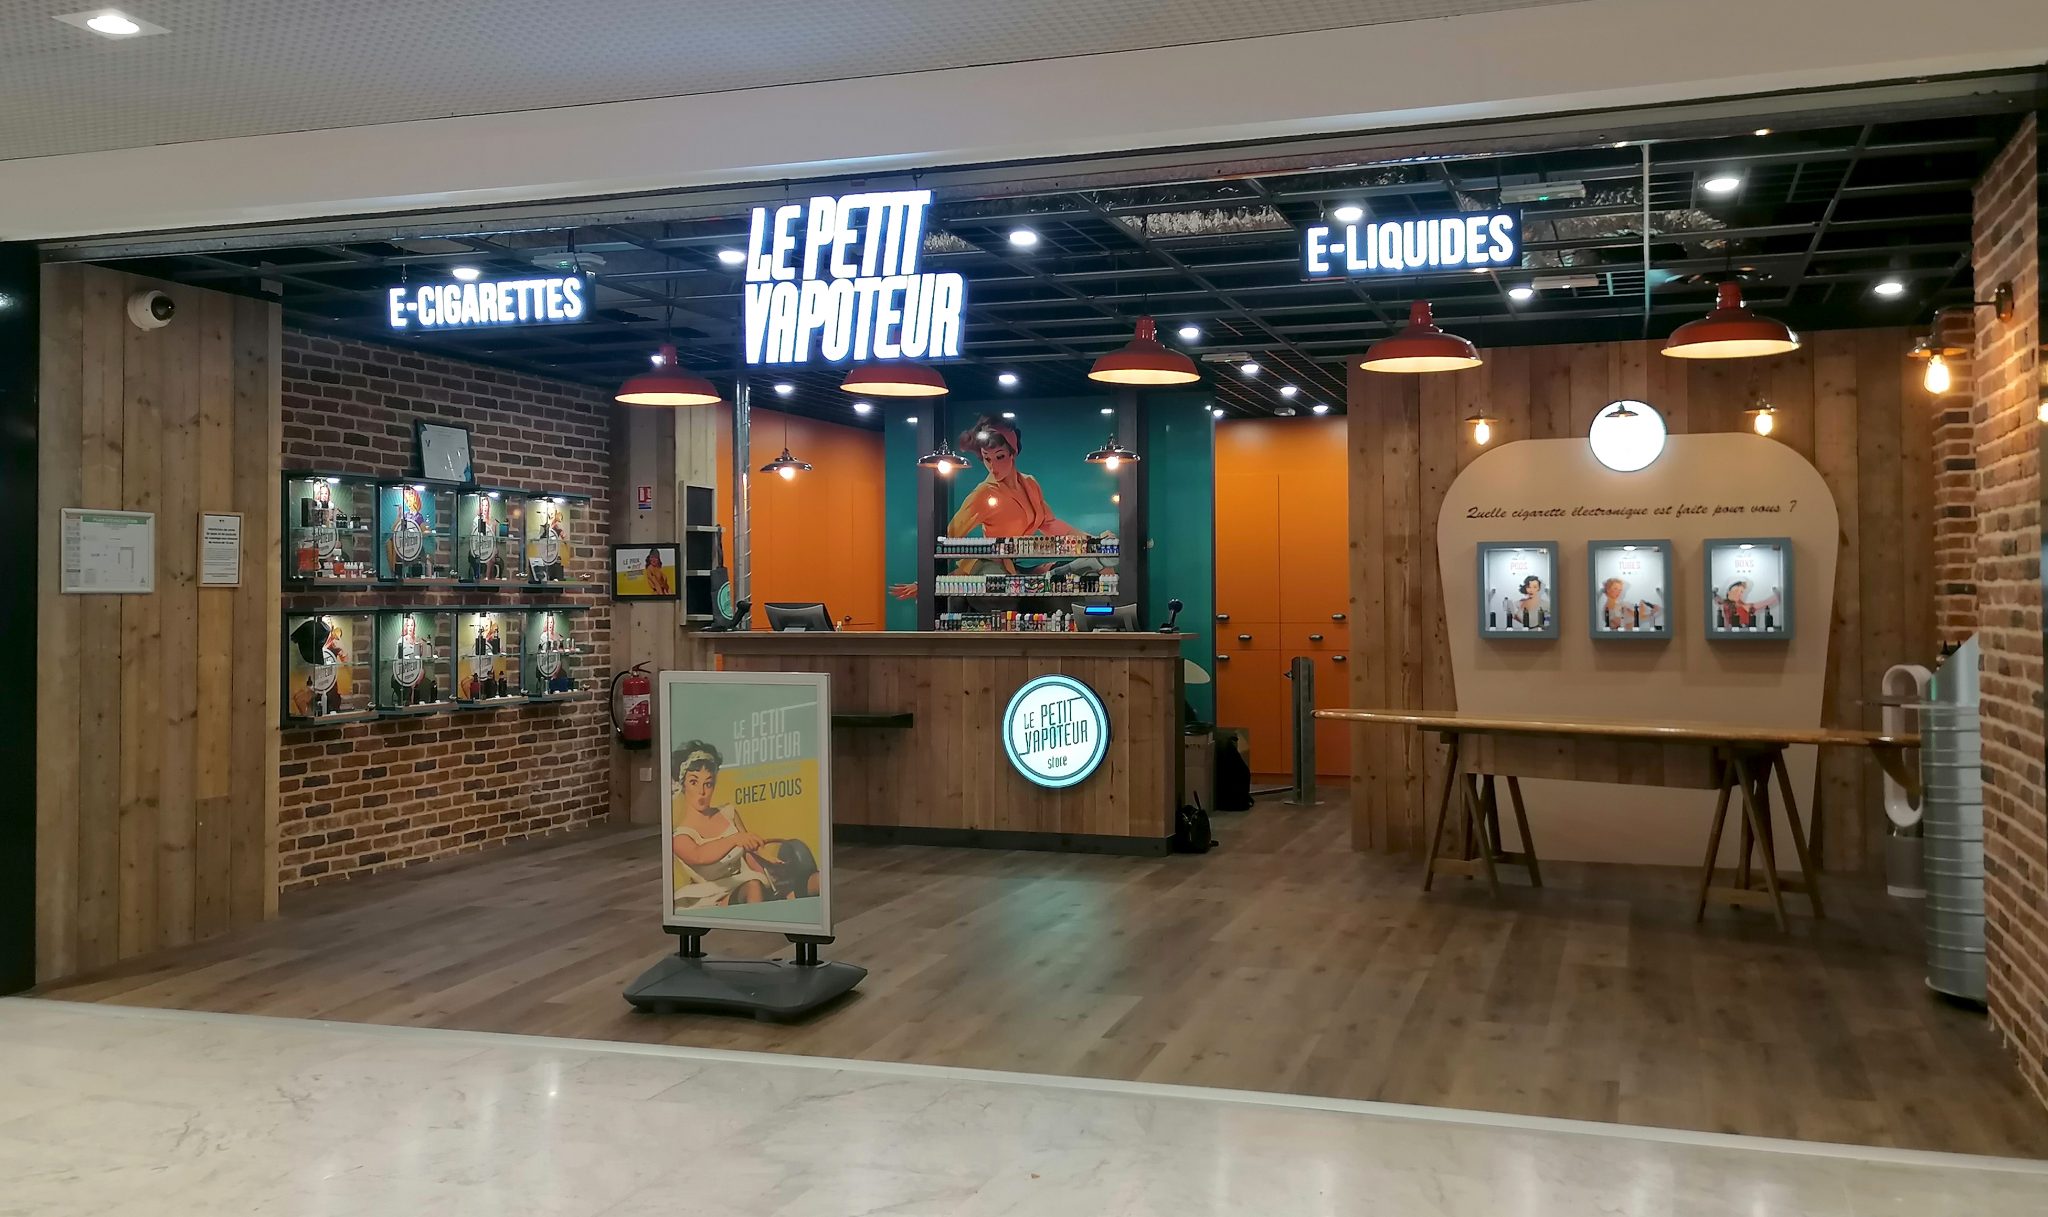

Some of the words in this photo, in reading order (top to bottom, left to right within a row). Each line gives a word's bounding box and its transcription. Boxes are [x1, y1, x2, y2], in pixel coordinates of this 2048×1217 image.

[745, 205, 801, 282] LE
[803, 190, 932, 280] PETIT
[1307, 214, 1514, 273] E-LIQUIDES
[389, 277, 581, 327] E-CIGARETTES
[745, 272, 964, 364] VAPOTEUR
[1466, 506, 1507, 519] Quelle
[1511, 508, 1566, 521] cigarette
[1571, 506, 1648, 520] électronique
[1653, 506, 1672, 515] est
[1675, 503, 1708, 518] faite
[1712, 504, 1744, 517] pour
[1750, 504, 1780, 513] vous
[1789, 500, 1797, 513] ?
[733, 719, 745, 740] LE
[751, 708, 787, 738] PETIT
[1023, 712, 1035, 729] LE
[1040, 699, 1072, 727] PETIT
[733, 731, 801, 766] VAPOTEUR
[1024, 720, 1088, 754] VAPOTEUR
[1047, 756, 1068, 770] store
[735, 784, 767, 805] CHEZ
[769, 778, 802, 800] VOUS
